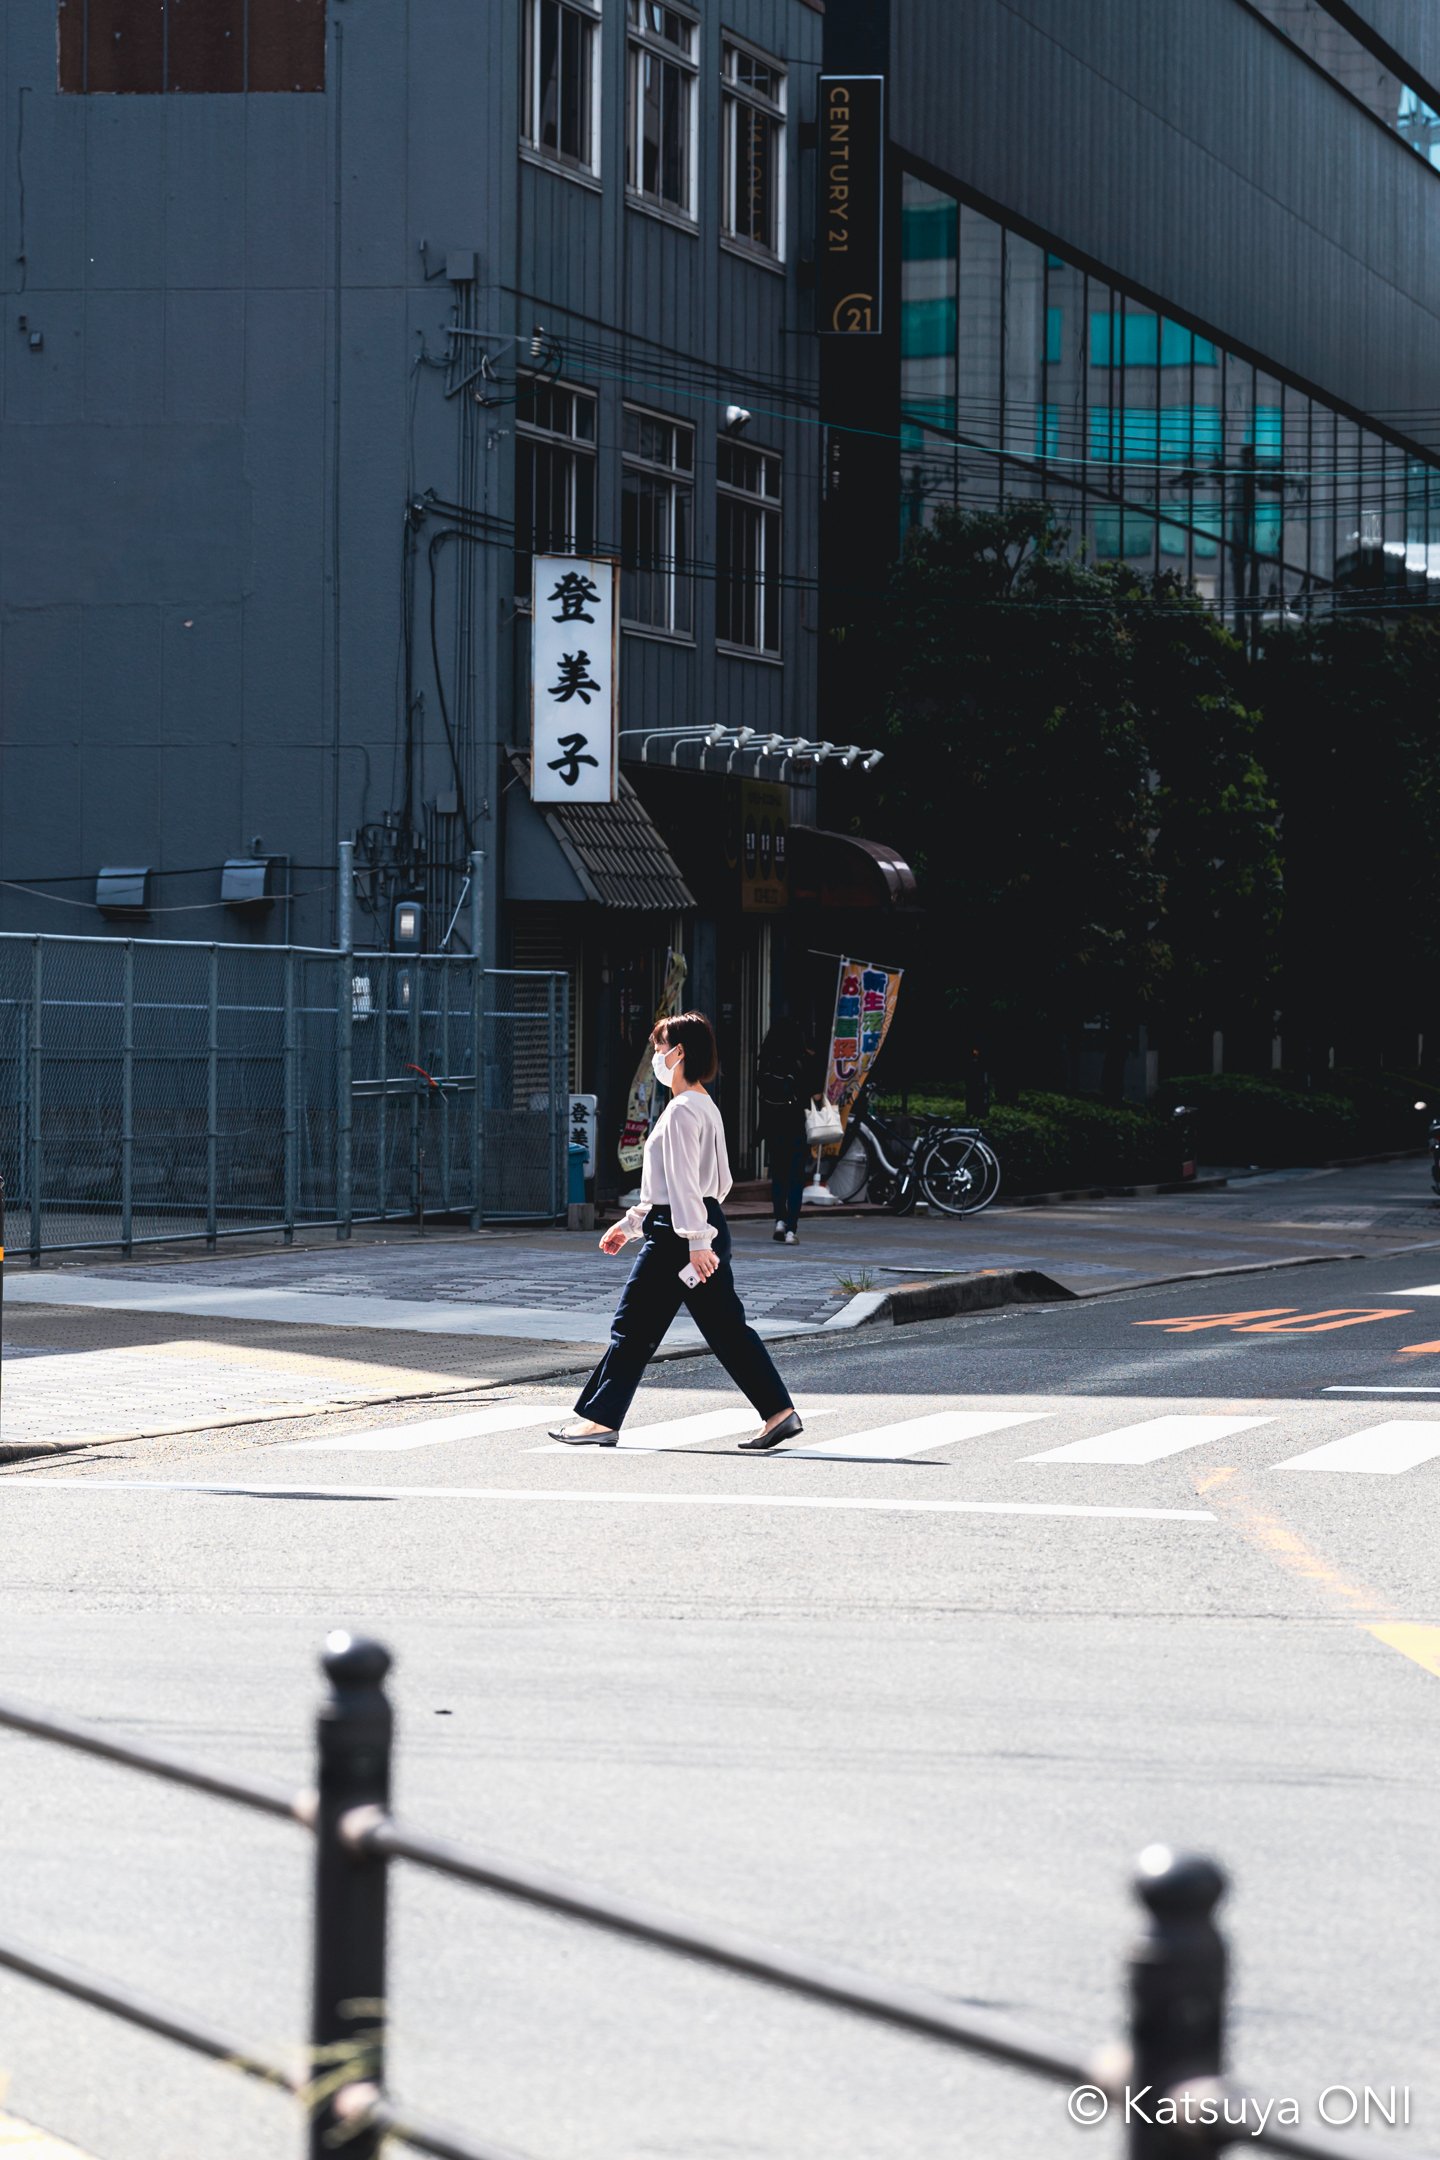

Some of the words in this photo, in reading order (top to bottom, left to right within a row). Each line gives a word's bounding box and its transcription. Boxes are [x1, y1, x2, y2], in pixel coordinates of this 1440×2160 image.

[829, 87, 849, 221] CENTURY
[828, 230, 848, 252] 21
[547, 571, 601, 786] 登美子
[570, 1102, 591, 1164] 登美
[1131, 1308, 1416, 1333] 40
